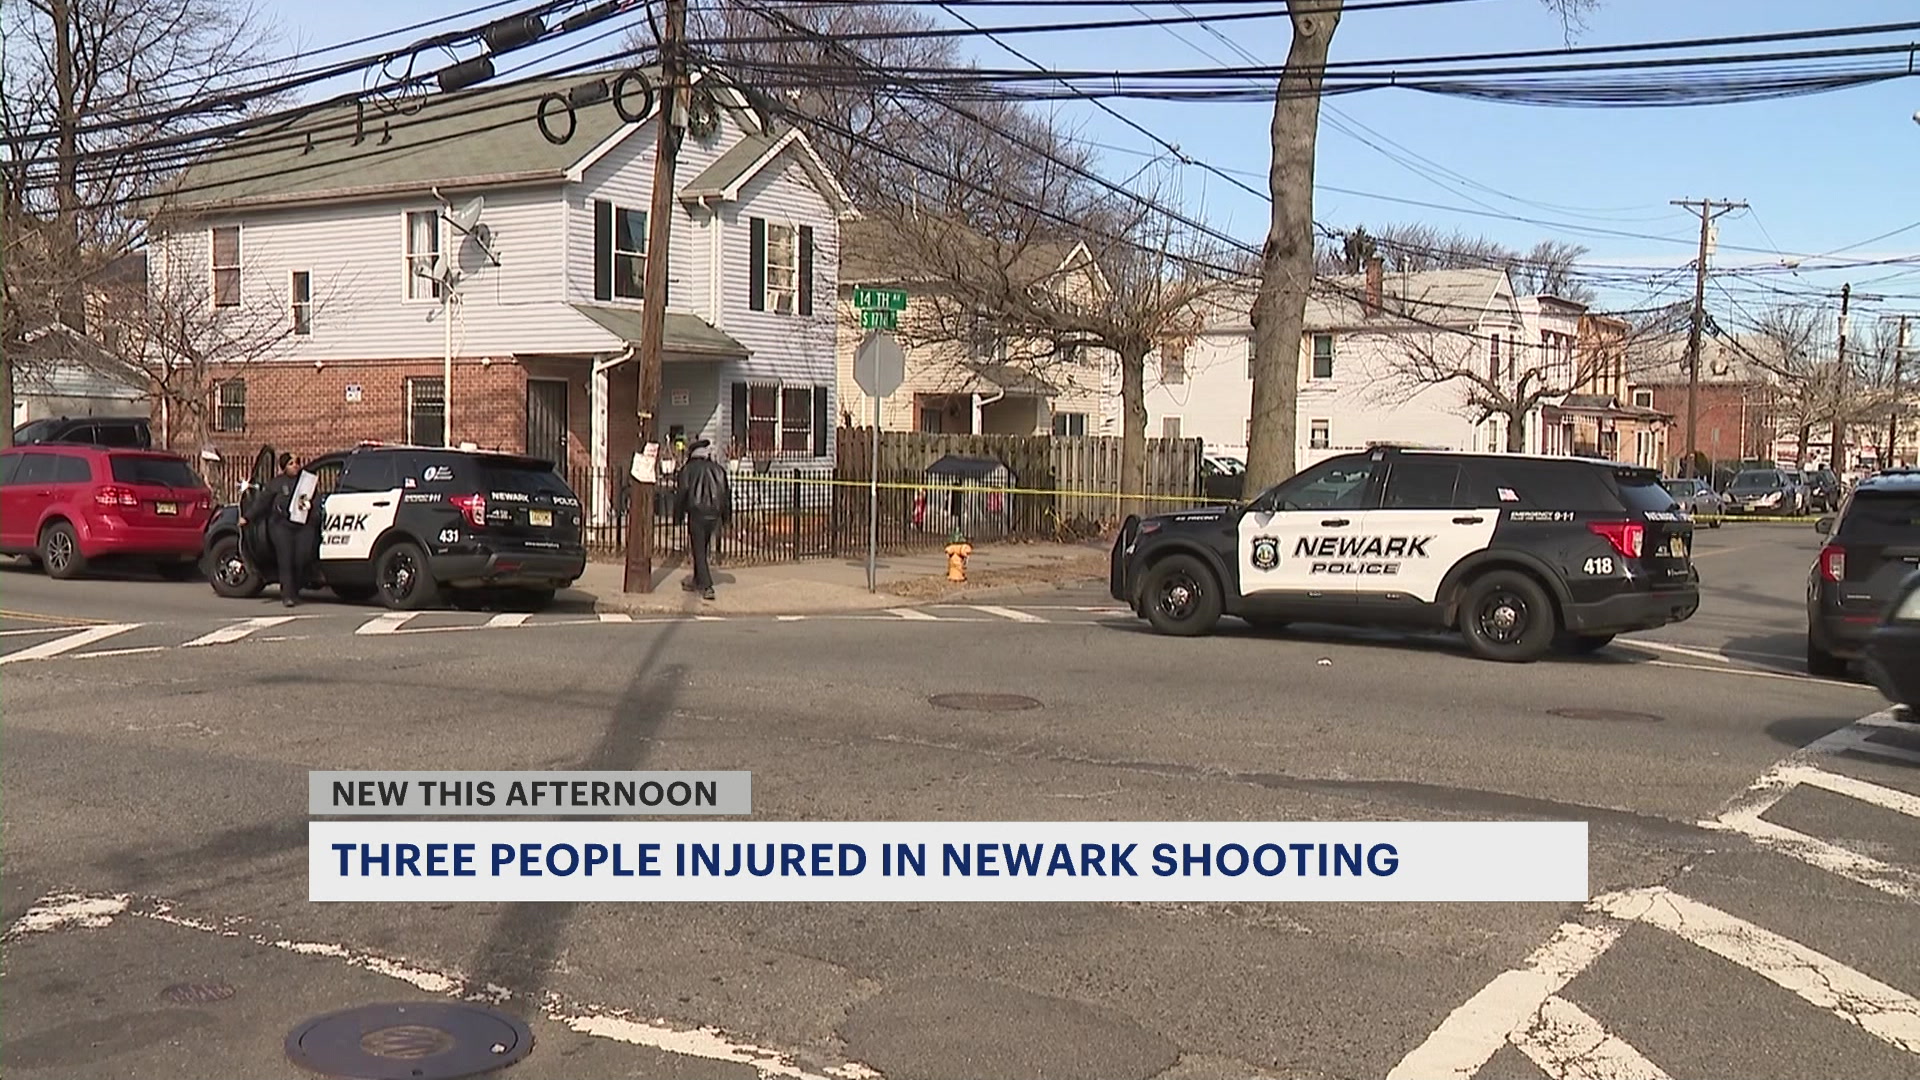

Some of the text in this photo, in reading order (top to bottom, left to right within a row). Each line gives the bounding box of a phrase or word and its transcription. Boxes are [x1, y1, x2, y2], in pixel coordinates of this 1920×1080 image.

[860, 291, 871, 306] 14
[876, 292, 890, 308] TH
[862, 311, 868, 326] S
[491, 492, 529, 503] NEWARK
[323, 514, 369, 531] WARK
[438, 530, 459, 543] 431
[1293, 536, 1432, 558] NEWARK
[1309, 562, 1401, 575] POLICE
[1582, 557, 1613, 575] 418
